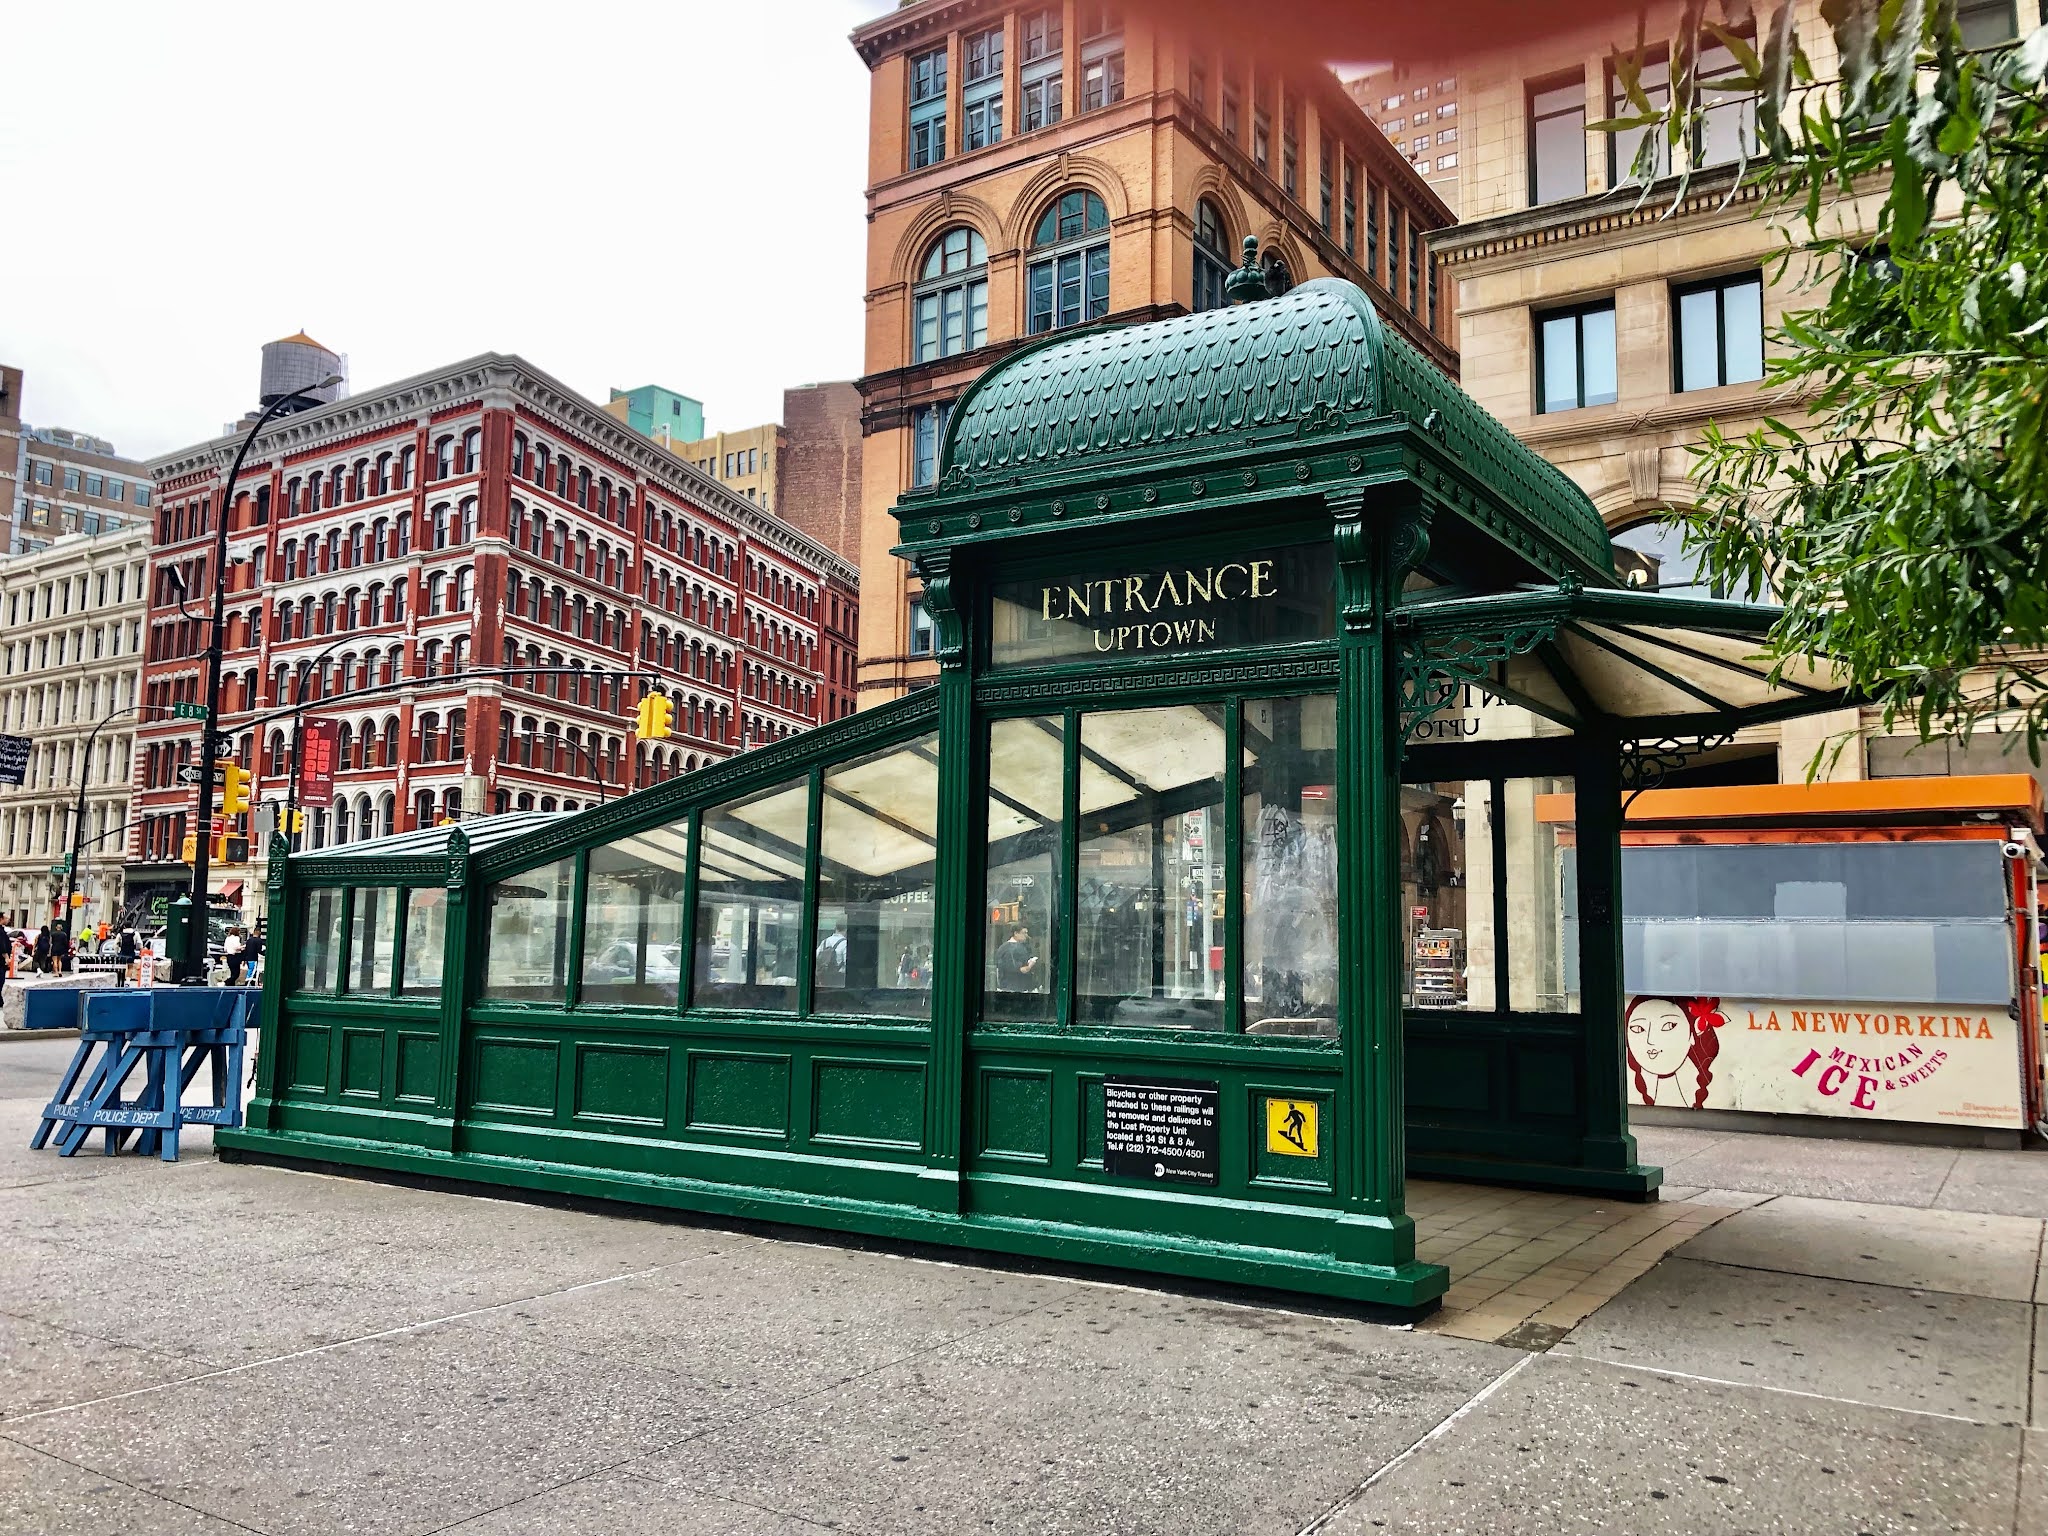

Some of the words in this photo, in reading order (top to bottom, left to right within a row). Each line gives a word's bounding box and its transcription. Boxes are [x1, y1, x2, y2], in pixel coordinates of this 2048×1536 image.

[1041, 560, 1278, 621] ENTRANCE
[1093, 617, 1216, 652] UPTOWN
[180, 704, 186, 716] E
[188, 705, 194, 717] 8
[304, 728, 319, 782] STAGE
[317, 739, 331, 773] RED
[184, 769, 200, 779] ONE
[1747, 1010, 1782, 1031] LA
[1791, 1011, 1995, 1039] NEWYORKINA
[1828, 1042, 1924, 1072] MEXICAN
[1885, 1079, 1896, 1091] &
[1898, 1049, 1948, 1089] SWEETS
[1791, 1048, 1879, 1111] ICE
[1106, 1088, 1136, 1099] Bicycles
[1149, 1092, 1168, 1101] other
[1170, 1095, 1202, 1105] property
[53, 1104, 79, 1118] POLICE
[196, 1108, 221, 1122] DEPT.
[1107, 1100, 1138, 1109] attached
[1141, 1102, 1148, 1110] to
[1151, 1103, 1171, 1112] these
[1174, 1105, 1199, 1115] railings
[1202, 1107, 1214, 1115] will
[93, 1110, 129, 1124] POLICE
[131, 1112, 159, 1125] DEPT.
[1107, 1110, 1116, 1118] be
[1119, 1112, 1149, 1121] removed
[1152, 1114, 1165, 1122] and
[1168, 1115, 1201, 1125] delivered
[1204, 1118, 1212, 1126] to
[1107, 1120, 1119, 1129] the
[1121, 1121, 1137, 1131] Lost
[1140, 1123, 1170, 1134] Property
[1173, 1126, 1187, 1135] Unit
[1107, 1131, 1133, 1141] located
[1136, 1134, 1143, 1142] at
[1145, 1135, 1155, 1143] 34
[1158, 1136, 1166, 1144] St
[1169, 1137, 1175, 1145] &
[1177, 1137, 1183, 1145] 8
[1186, 1138, 1195, 1147] Av
[1107, 1142, 1124, 1151] Tel.#
[1126, 1143, 1144, 1153] (212)
[1146, 1146, 1204, 1159] 712-4500/4501
